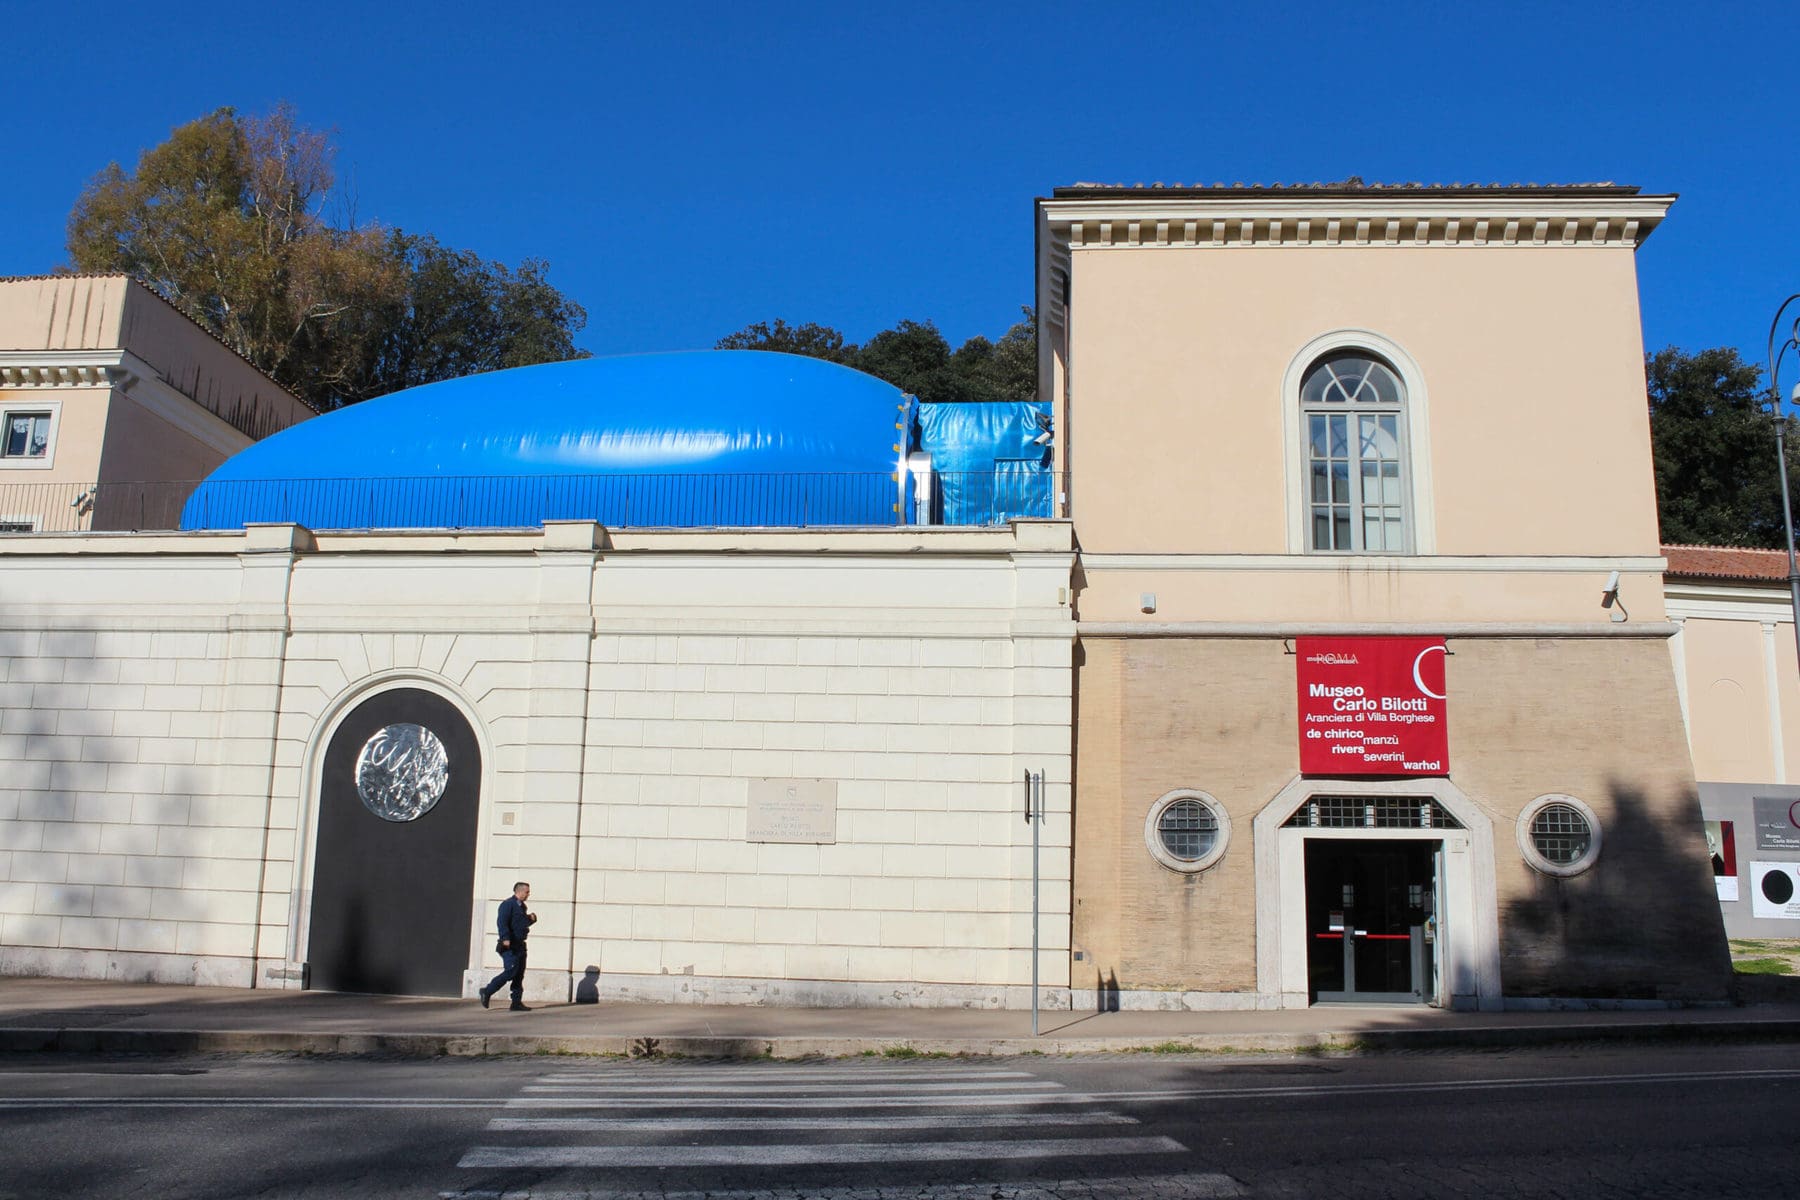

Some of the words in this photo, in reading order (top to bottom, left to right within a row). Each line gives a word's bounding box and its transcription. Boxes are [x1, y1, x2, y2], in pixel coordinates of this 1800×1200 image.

[1309, 684, 1364, 697] Museo
[1333, 698, 1377, 711] Carlo
[1381, 697, 1427, 711] Bilotti
[1305, 713, 1353, 722] Aranciera
[1355, 713, 1364, 722] di
[1367, 712, 1387, 722] Villa
[1389, 713, 1435, 724] Borghese
[1306, 729, 1321, 739] de
[1324, 729, 1364, 739] chirico
[1363, 734, 1399, 745] manzù
[1332, 744, 1365, 754] rivers
[1364, 752, 1405, 761] severini
[1403, 760, 1440, 770] warhol
